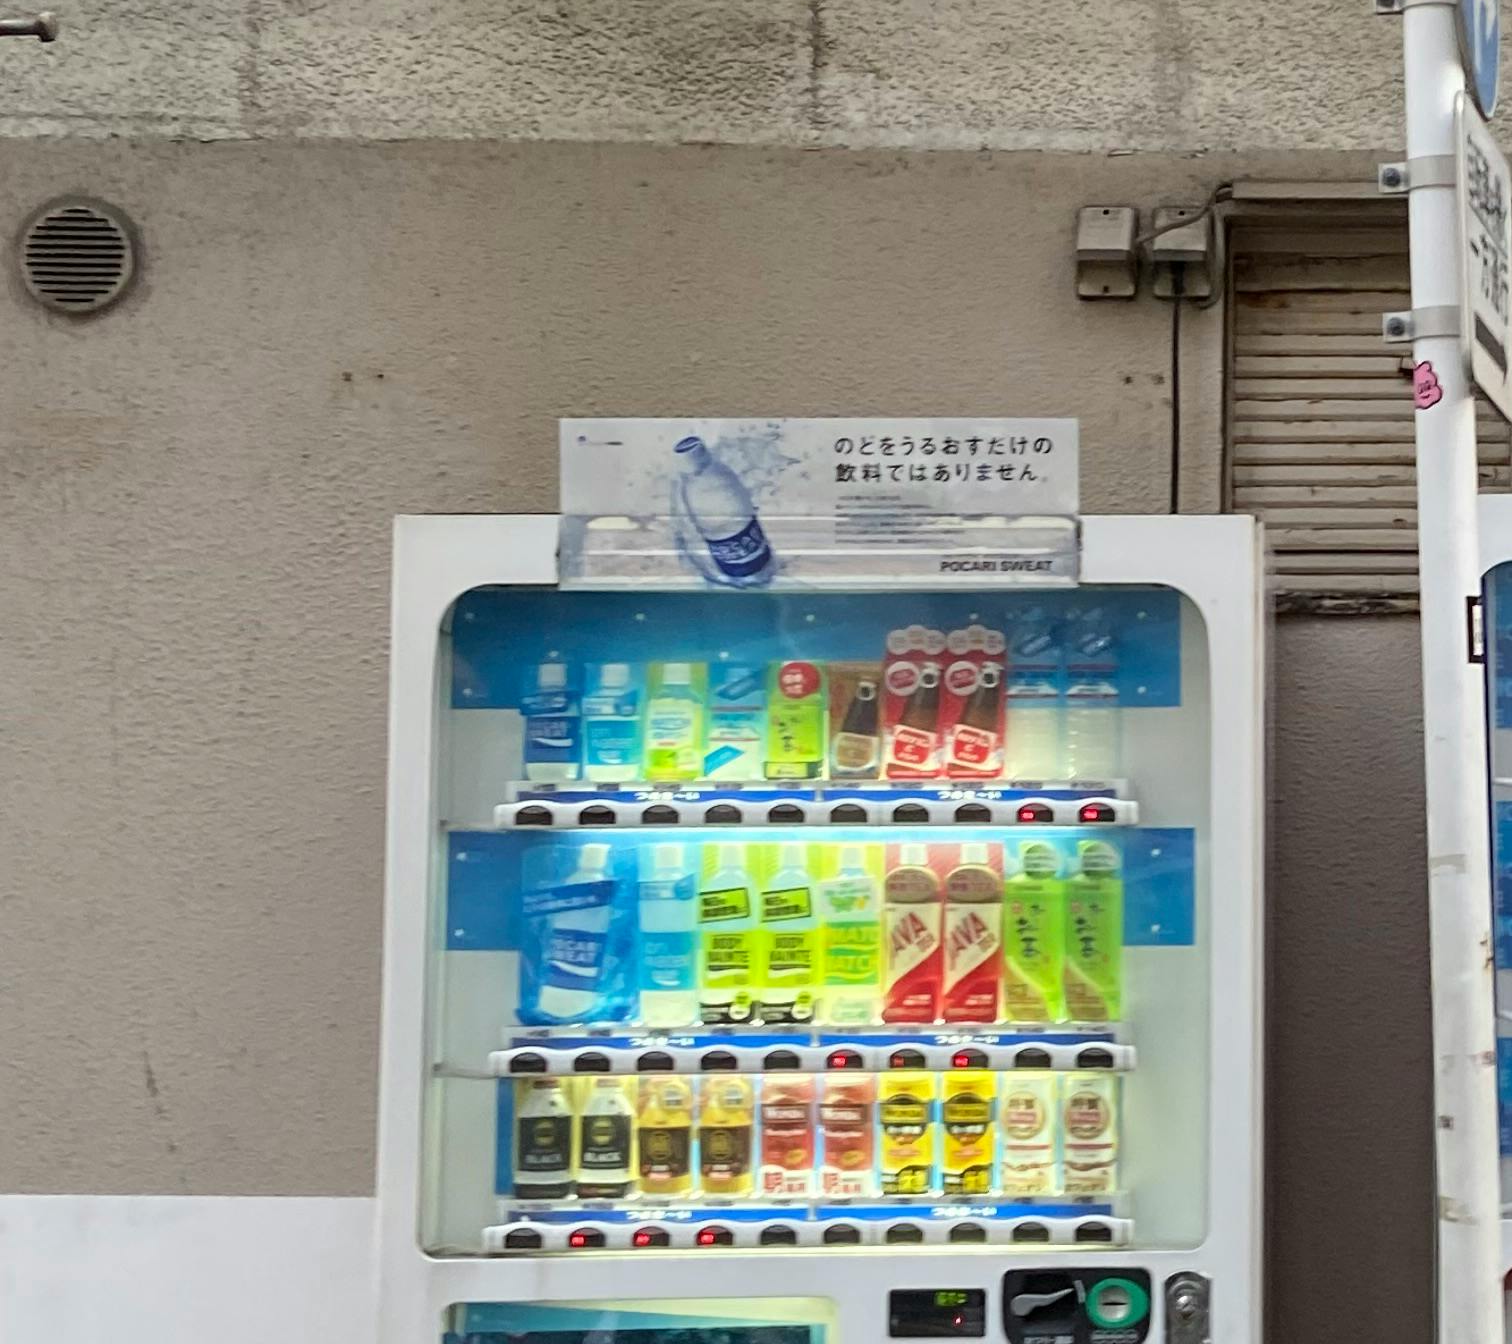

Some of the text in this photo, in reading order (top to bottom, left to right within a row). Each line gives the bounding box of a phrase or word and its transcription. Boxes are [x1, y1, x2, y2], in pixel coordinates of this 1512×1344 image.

[834, 436, 1053, 456] のどをうるおすだけの
[940, 560, 1053, 572] POCARI SWEAT
